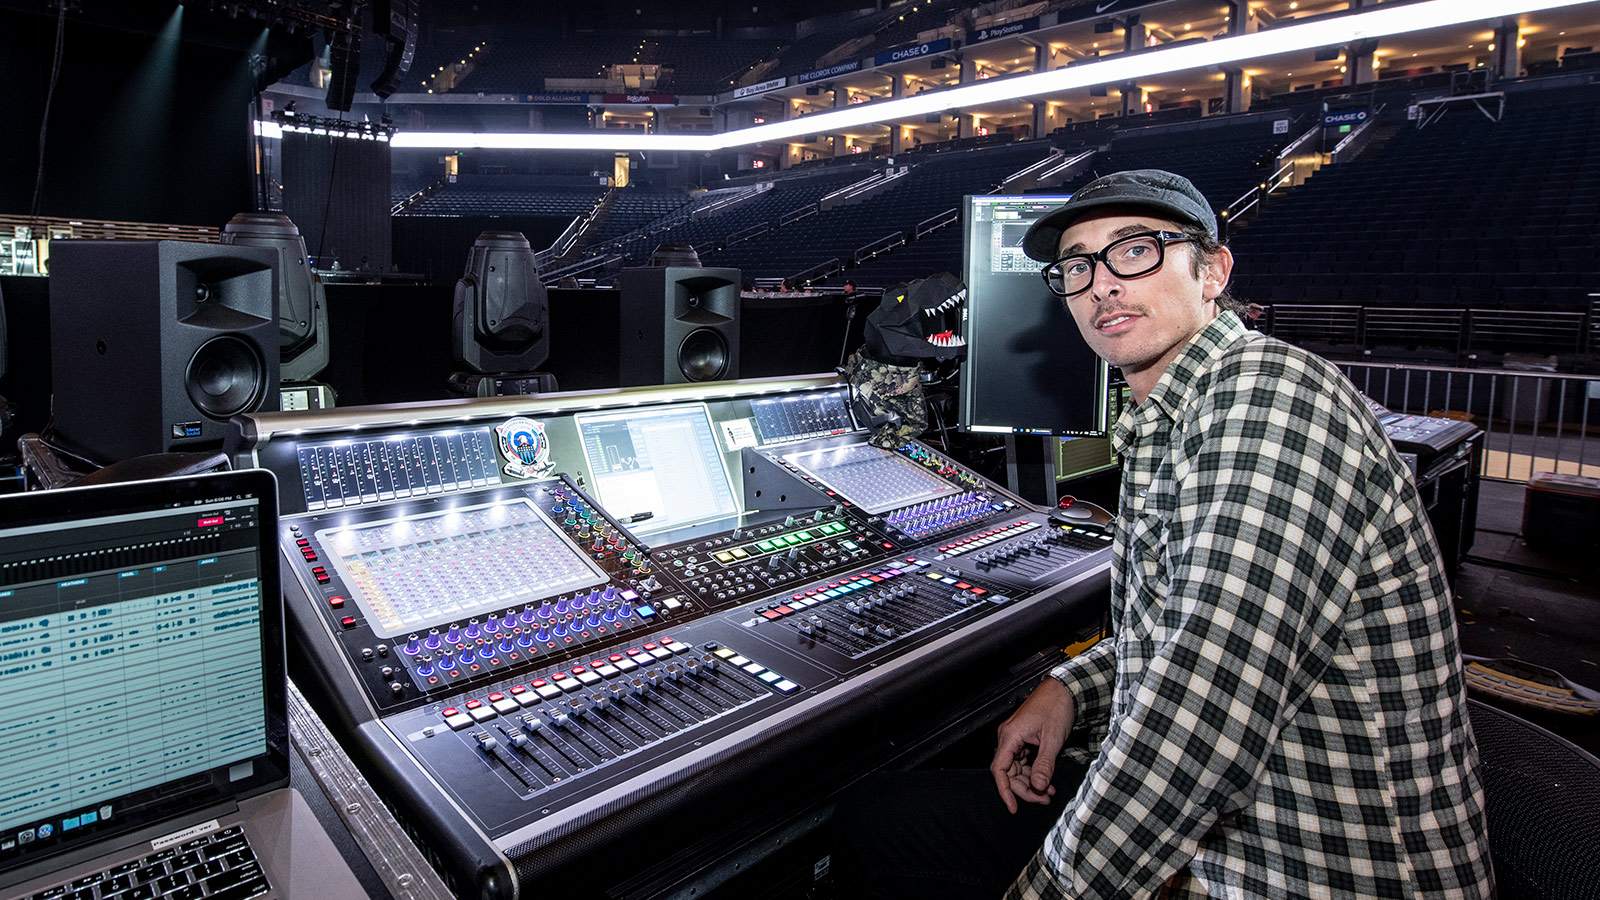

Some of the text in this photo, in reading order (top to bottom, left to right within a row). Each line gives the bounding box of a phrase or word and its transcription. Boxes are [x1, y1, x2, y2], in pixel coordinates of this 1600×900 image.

[990, 23, 1024, 37] PlayStation
[892, 46, 920, 60] CHASE
[800, 62, 858, 81] THE CLOROX COMPANY
[746, 80, 780, 95] Bay Area BMW
[626, 95, 650, 103] Rakuten
[1324, 113, 1357, 123] CHASE
